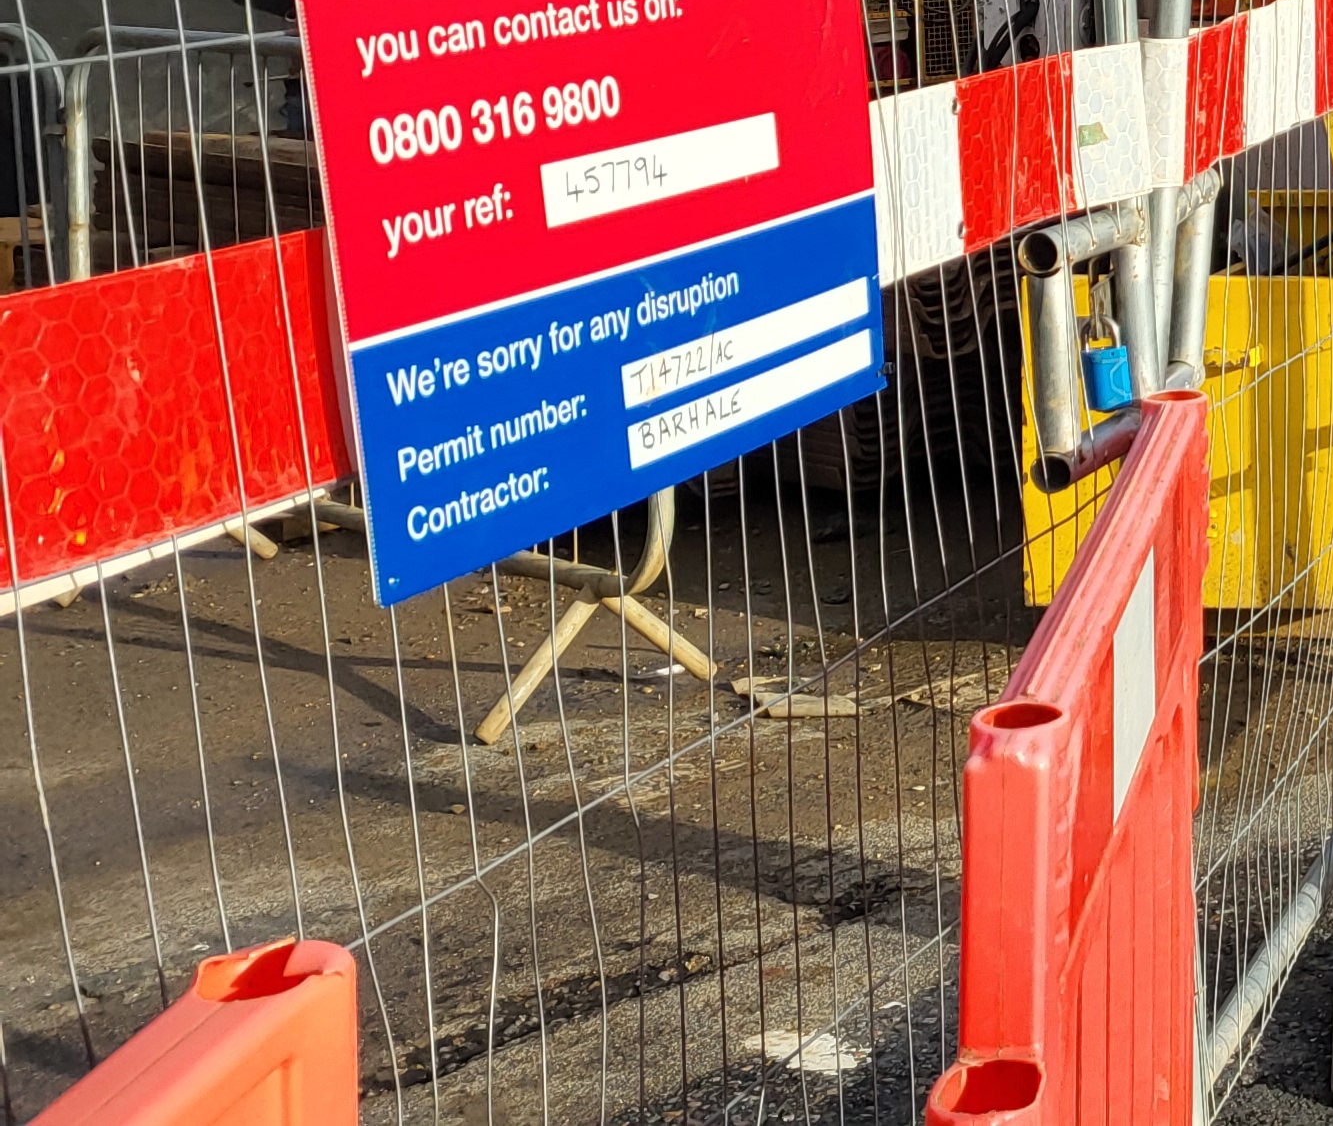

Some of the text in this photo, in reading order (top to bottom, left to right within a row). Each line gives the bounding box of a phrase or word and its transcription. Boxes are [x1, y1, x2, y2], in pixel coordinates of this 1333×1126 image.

[356, 22, 419, 76] you
[427, 14, 486, 54] can
[369, 75, 621, 165] 0800 316 9800
[565, 154, 669, 204] 457794
[382, 184, 514, 259] your ref:
[386, 268, 740, 407] We're sorry for any disruption
[397, 390, 588, 483] Permit number:
[637, 389, 744, 451] BARHALE
[407, 466, 551, 541] Contractor:
